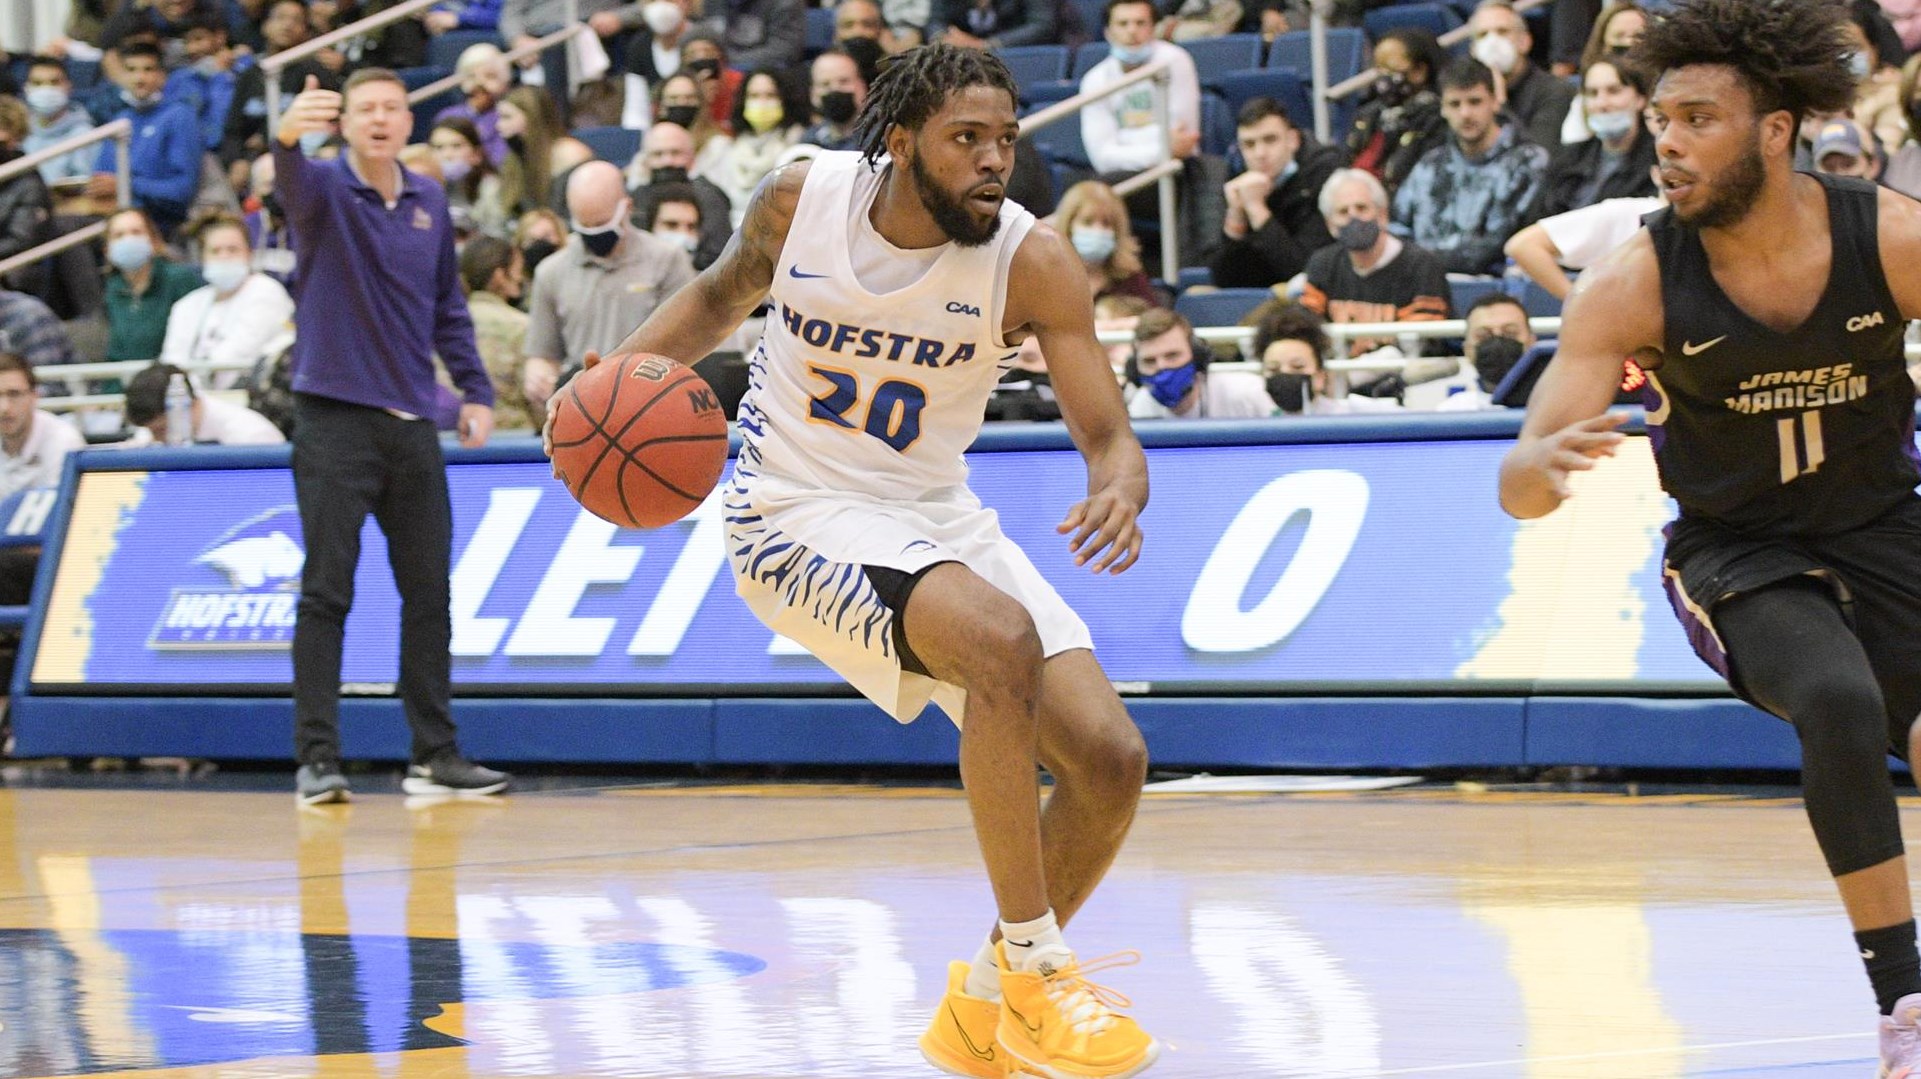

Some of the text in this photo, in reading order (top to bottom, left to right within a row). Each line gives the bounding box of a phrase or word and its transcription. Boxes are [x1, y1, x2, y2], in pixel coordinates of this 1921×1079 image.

[946, 302, 981, 318] CAA
[1846, 311, 1884, 332] CAA
[782, 302, 976, 368] HOFSTRA
[1724, 375, 1867, 414] MADISON
[1739, 363, 1853, 390] JAMES
[804, 360, 930, 455] 20
[1776, 410, 1825, 485] 11
[165, 593, 297, 628] HOFSTR
